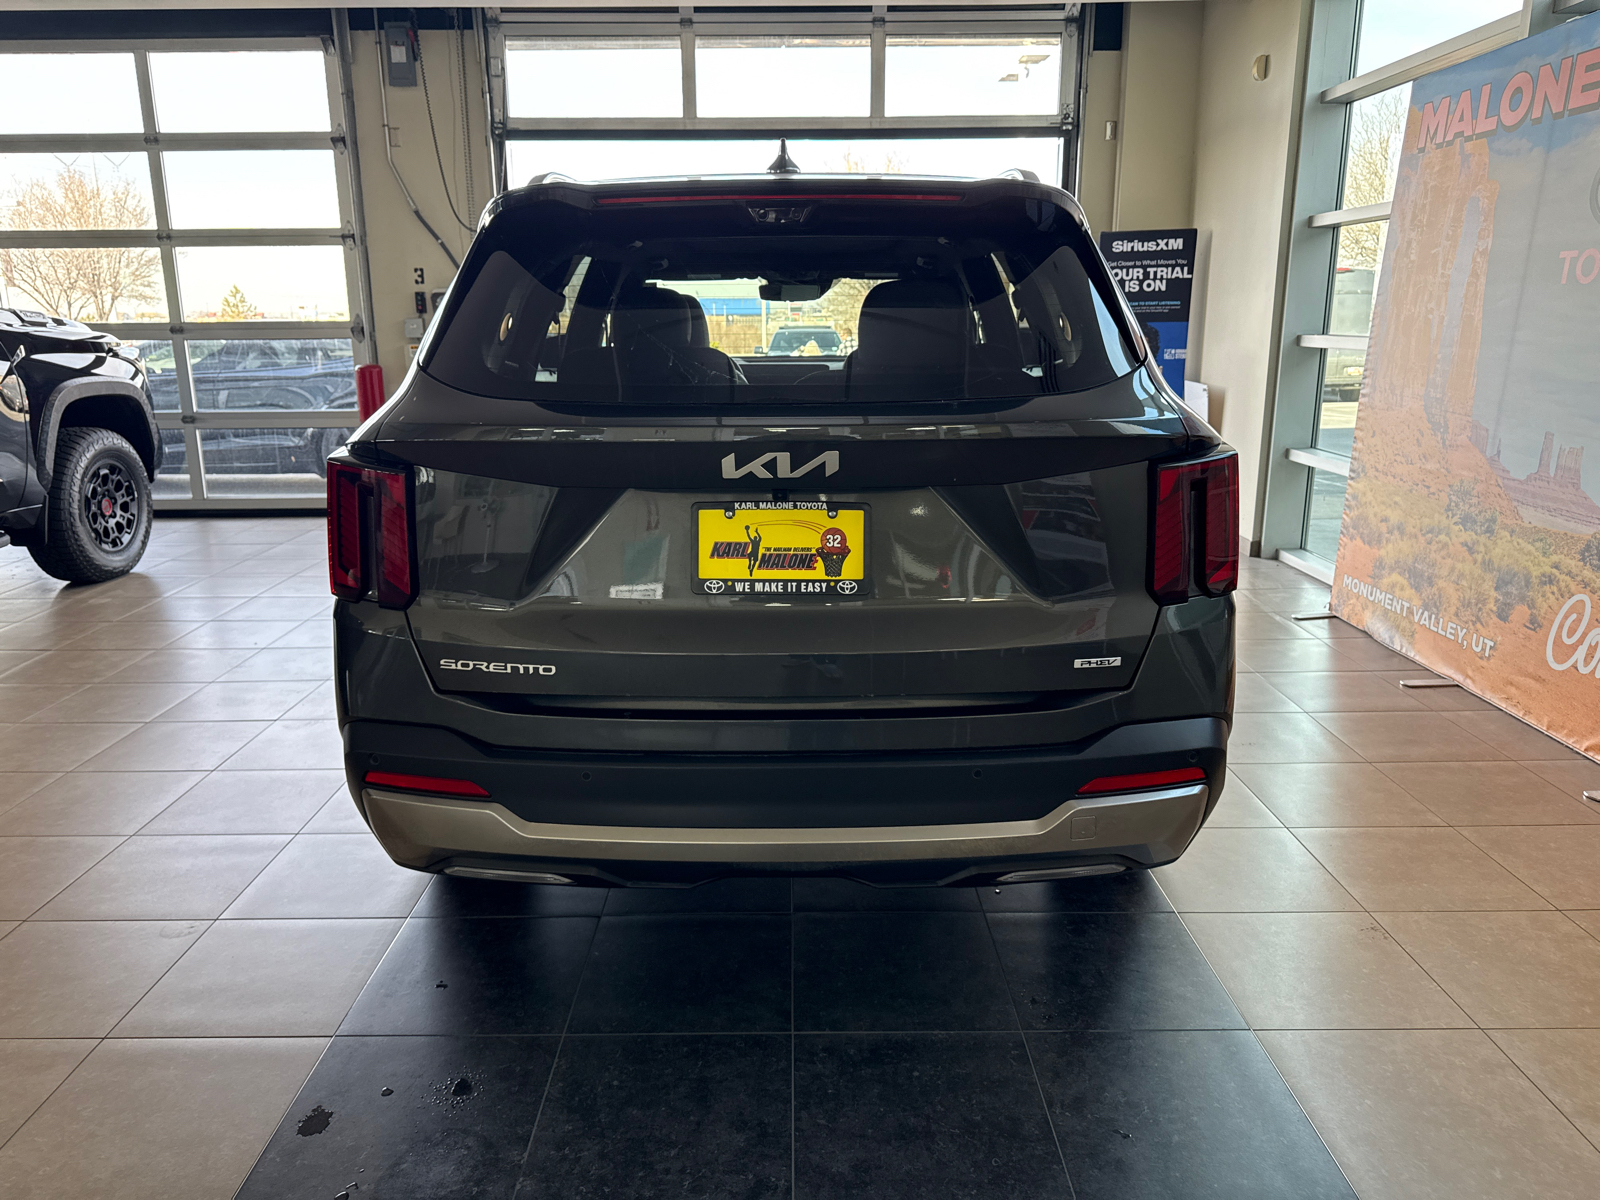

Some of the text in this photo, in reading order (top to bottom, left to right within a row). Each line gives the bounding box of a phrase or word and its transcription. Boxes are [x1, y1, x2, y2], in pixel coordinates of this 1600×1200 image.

[1417, 47, 1600, 154] MALONE
[1112, 238, 1184, 253] SiriusXM
[1112, 266, 1192, 280] OUR TRIAL
[1559, 248, 1600, 285] TO
[414, 268, 425, 285] 3
[1124, 279, 1167, 293] IS ON
[721, 450, 840, 479] KIA
[734, 502, 828, 510] KARL MALONE TOYOTA
[826, 534, 842, 547] 32
[709, 541, 751, 559] KARL
[757, 553, 818, 570] MALONE
[735, 582, 827, 593] WE MAKE IT EASY
[1343, 574, 1495, 657] MONUMENT VALLEY, UT
[1546, 593, 1600, 678] Co
[440, 658, 556, 676] SORENTO
[1080, 659, 1118, 667] PHEV
